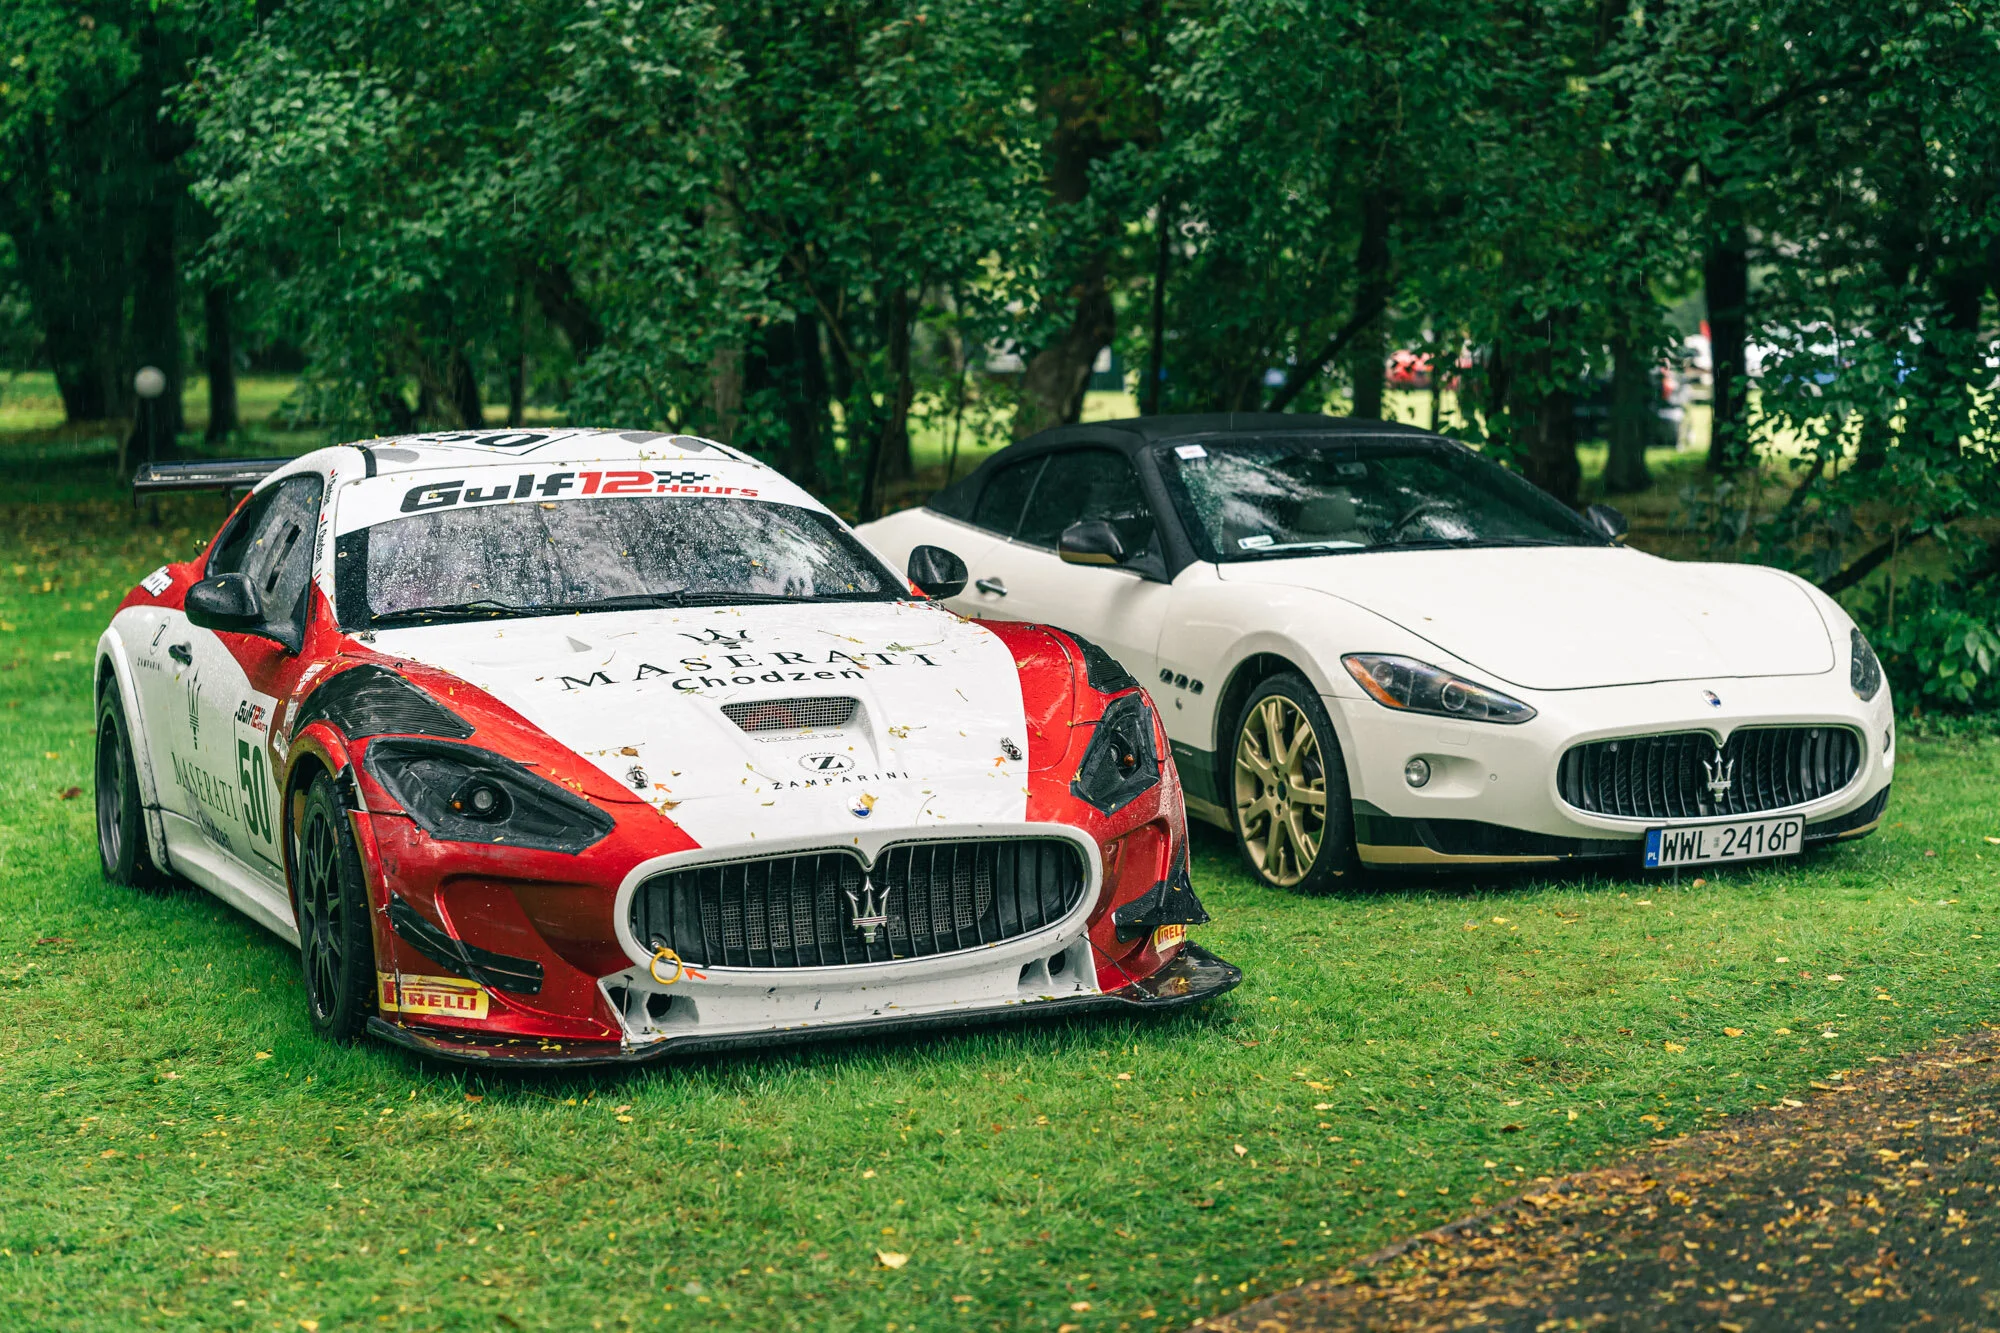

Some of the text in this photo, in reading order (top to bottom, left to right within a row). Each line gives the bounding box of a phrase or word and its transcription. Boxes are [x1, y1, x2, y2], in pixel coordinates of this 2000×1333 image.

[657, 484, 759, 497] Hours
[557, 650, 942, 691] MASERATI
[672, 667, 865, 691] Chodzeń
[171, 751, 239, 821] MASERATI
[238, 738, 272, 844] 50
[772, 772, 908, 790] ZAMPARINI
[1648, 852, 1657, 861] PL
[1663, 821, 1799, 862] WWL 2416P
[383, 980, 477, 1011] PIRELLI
